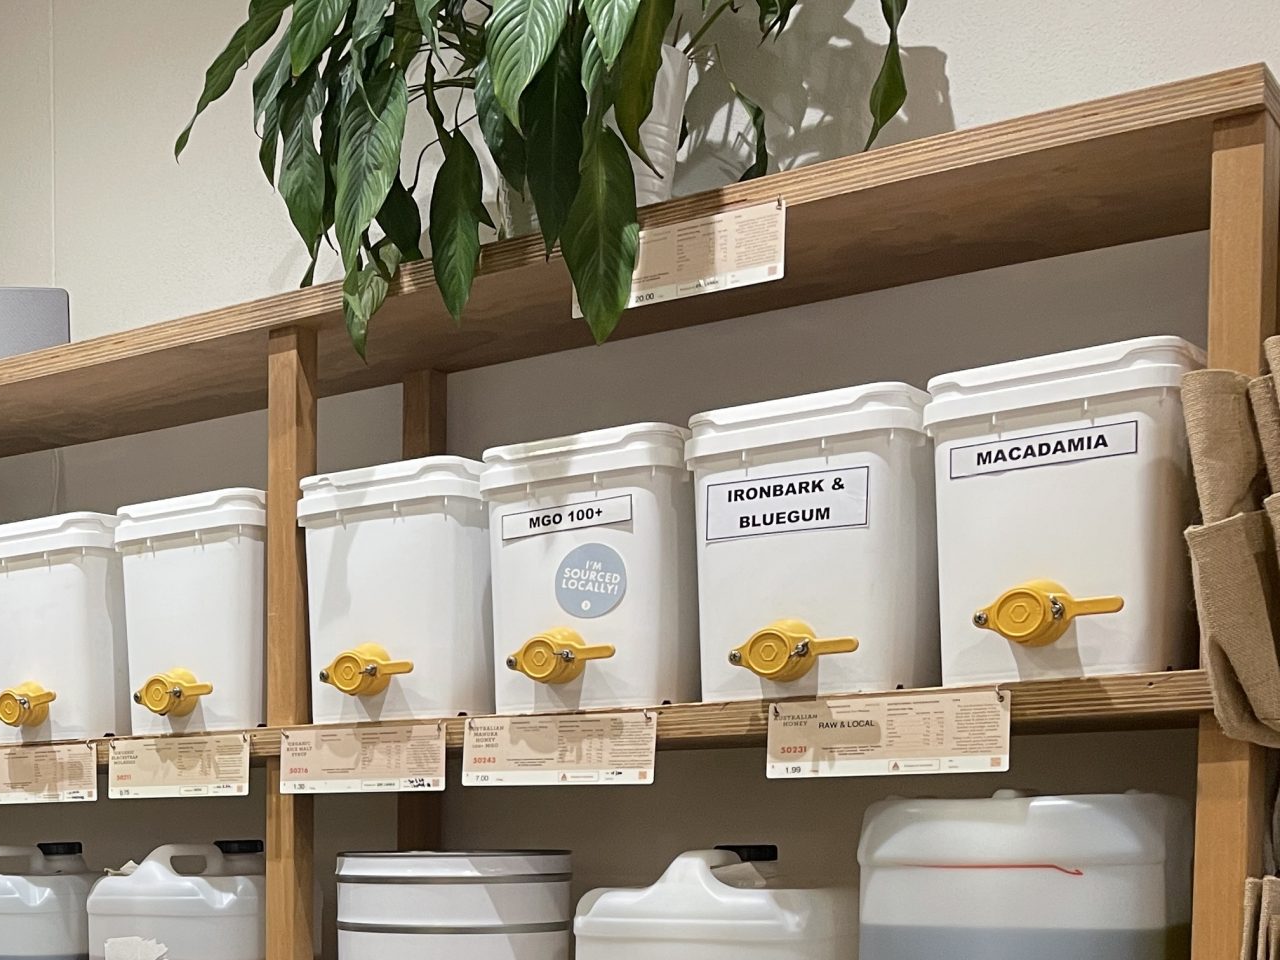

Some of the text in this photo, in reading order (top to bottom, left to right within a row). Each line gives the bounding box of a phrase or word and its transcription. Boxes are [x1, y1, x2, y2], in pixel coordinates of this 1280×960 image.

[976, 434, 1109, 466] MACADAMIA
[727, 477, 845, 503] IRONBARK &
[529, 507, 603, 529] MGO 100+
[738, 507, 831, 529] BLUEGUM
[585, 560, 602, 570] I'M
[563, 567, 621, 584] SOURCED
[561, 579, 619, 595] LOCALLY!
[818, 719, 875, 729] RAW & LOCAL
[780, 745, 807, 754] 50231
[785, 766, 802, 774] 1.99
